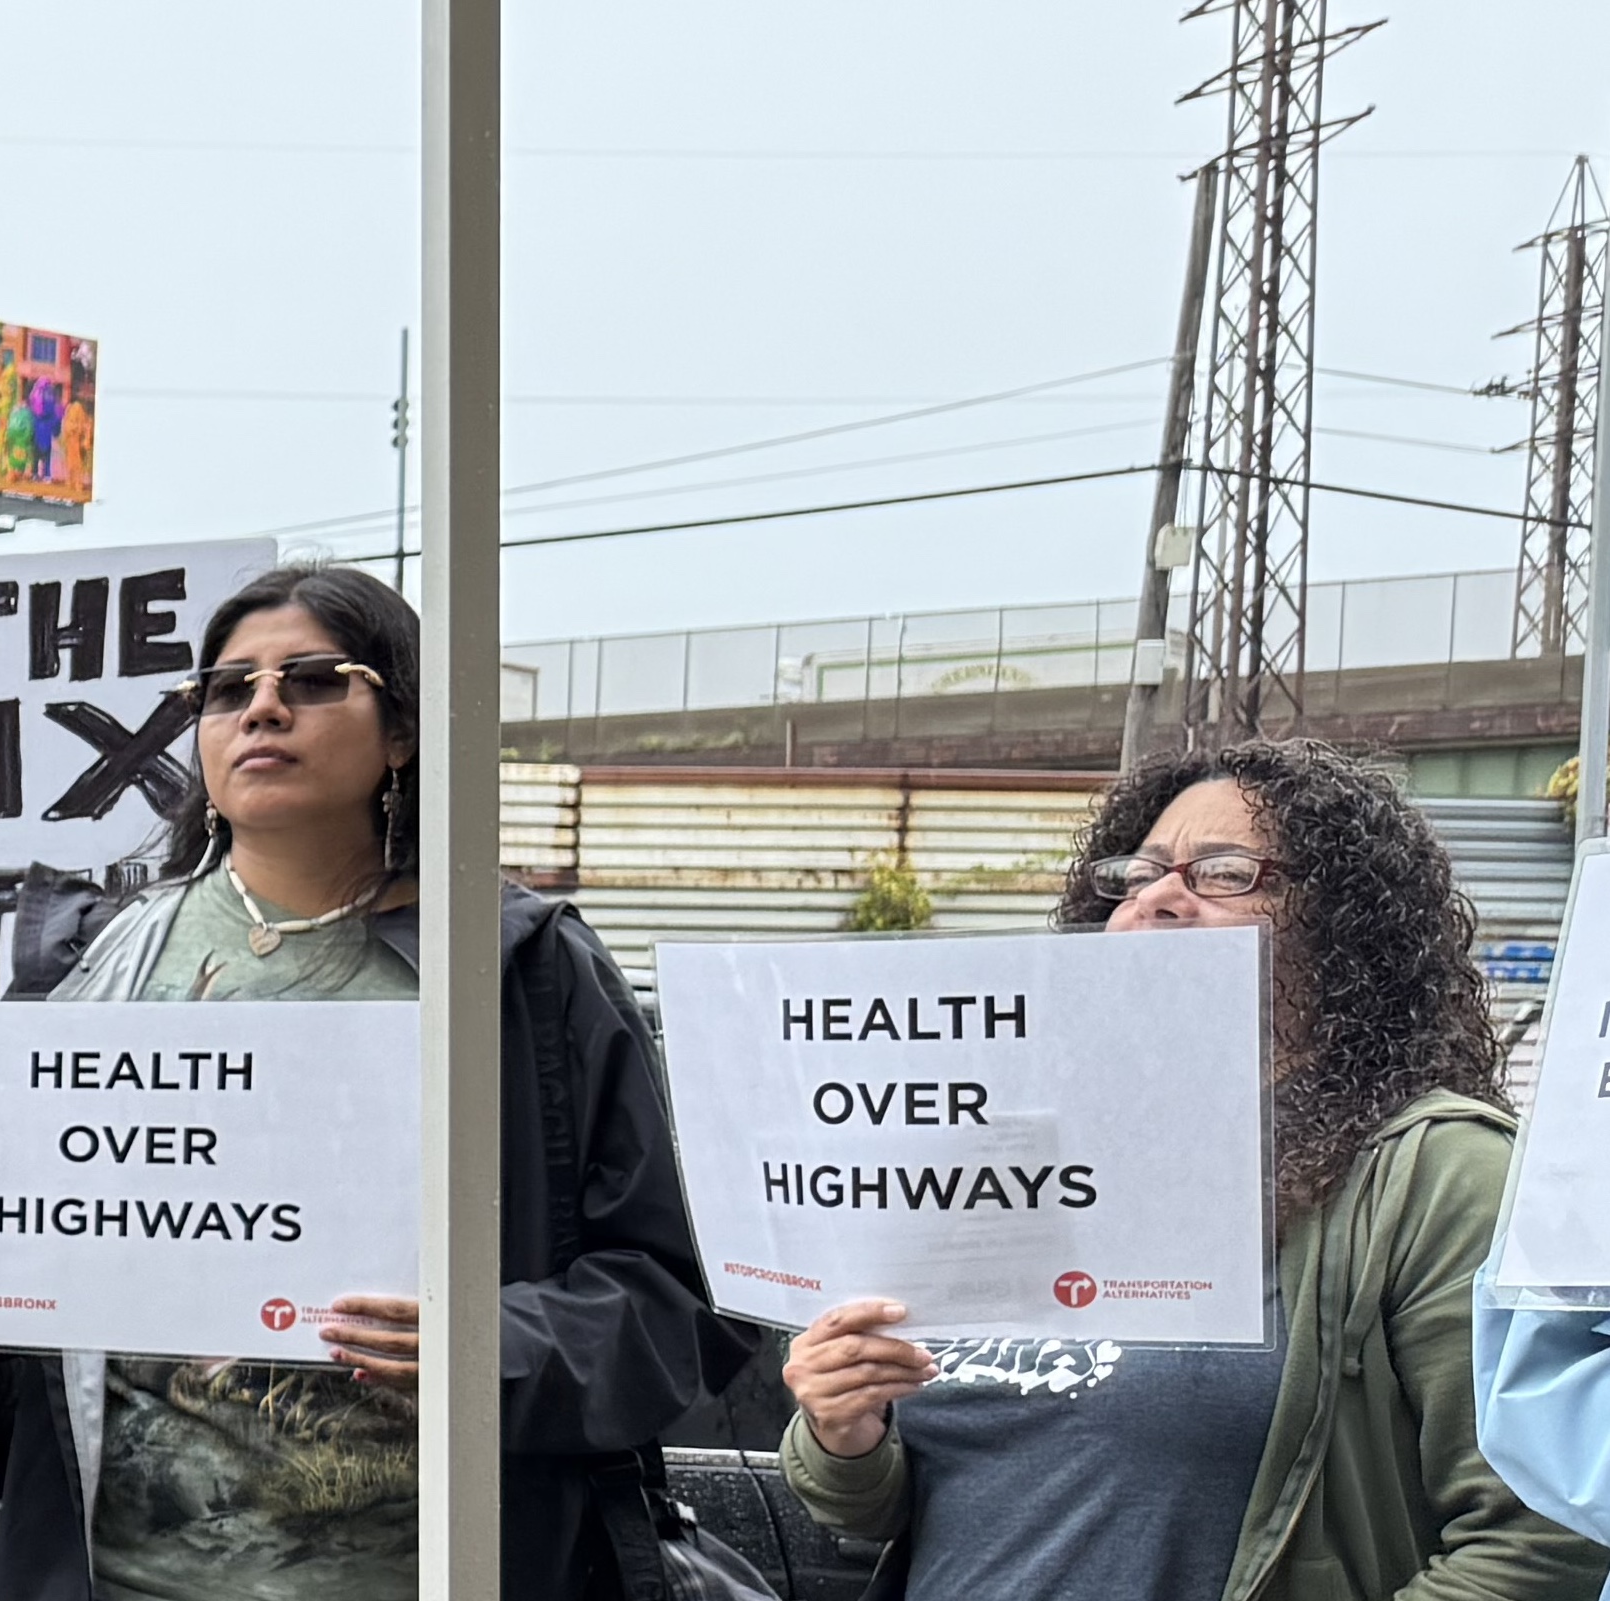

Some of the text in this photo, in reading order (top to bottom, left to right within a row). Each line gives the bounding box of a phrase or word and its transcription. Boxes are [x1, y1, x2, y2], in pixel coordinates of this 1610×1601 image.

[782, 994, 1027, 1042] HEALTH
[29, 1050, 254, 1091] HEALTH
[813, 1081, 990, 1126] OVER
[59, 1126, 217, 1165] OVER
[763, 1160, 1098, 1211] HIGHWAYS
[1102, 1280, 1213, 1290] TRANSPORTATION
[1102, 1290, 1191, 1300] ALTERNATIVES
